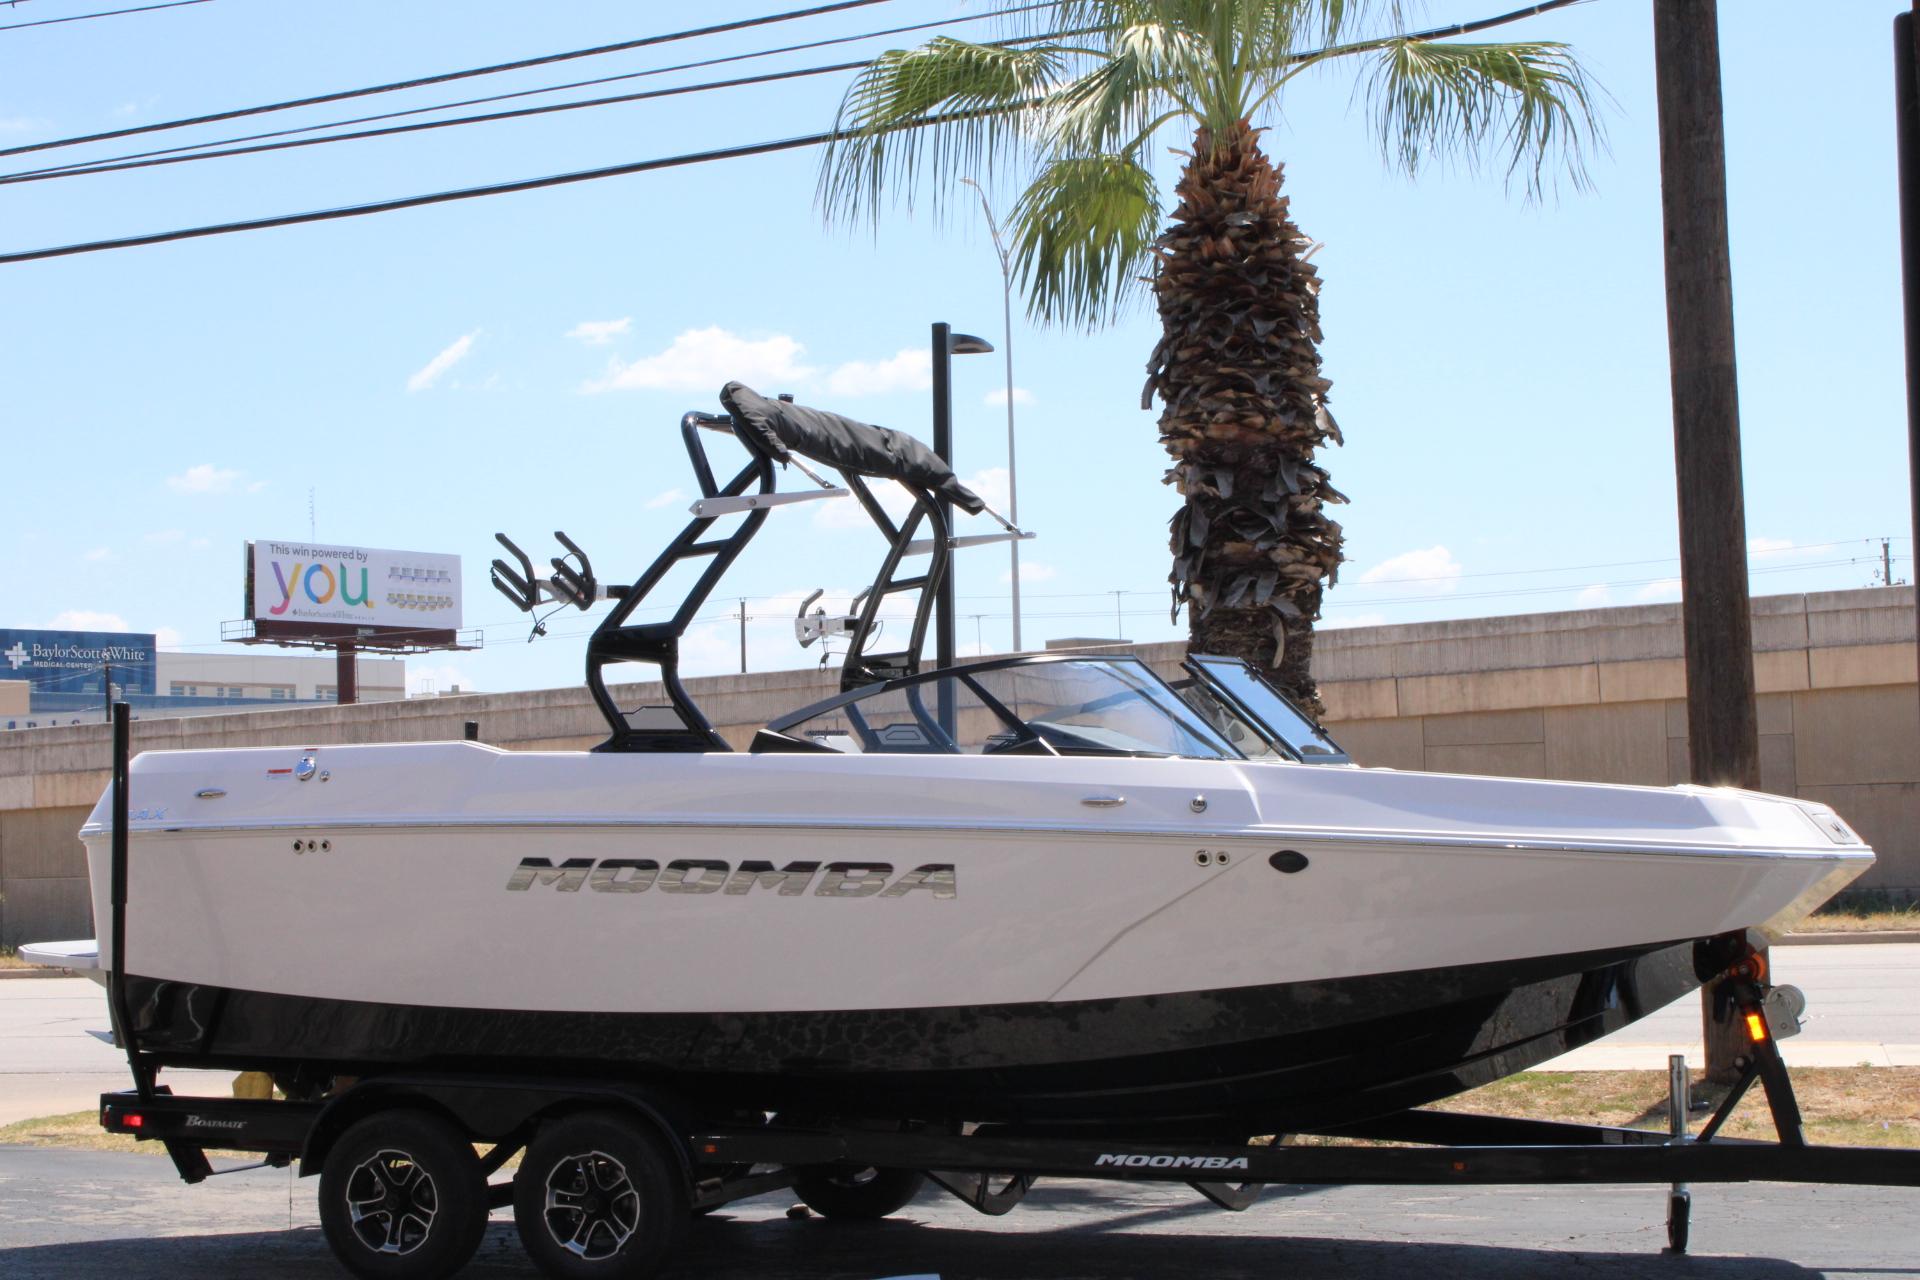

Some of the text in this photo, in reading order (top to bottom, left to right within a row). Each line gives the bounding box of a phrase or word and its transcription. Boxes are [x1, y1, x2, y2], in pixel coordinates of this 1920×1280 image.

[270, 543, 368, 563] This win powered by
[269, 561, 375, 616] you
[33, 661, 63, 669] MEDICAL
[505, 857, 957, 899] MOOMBA
[1095, 1154, 1249, 1169] MOOMBA
